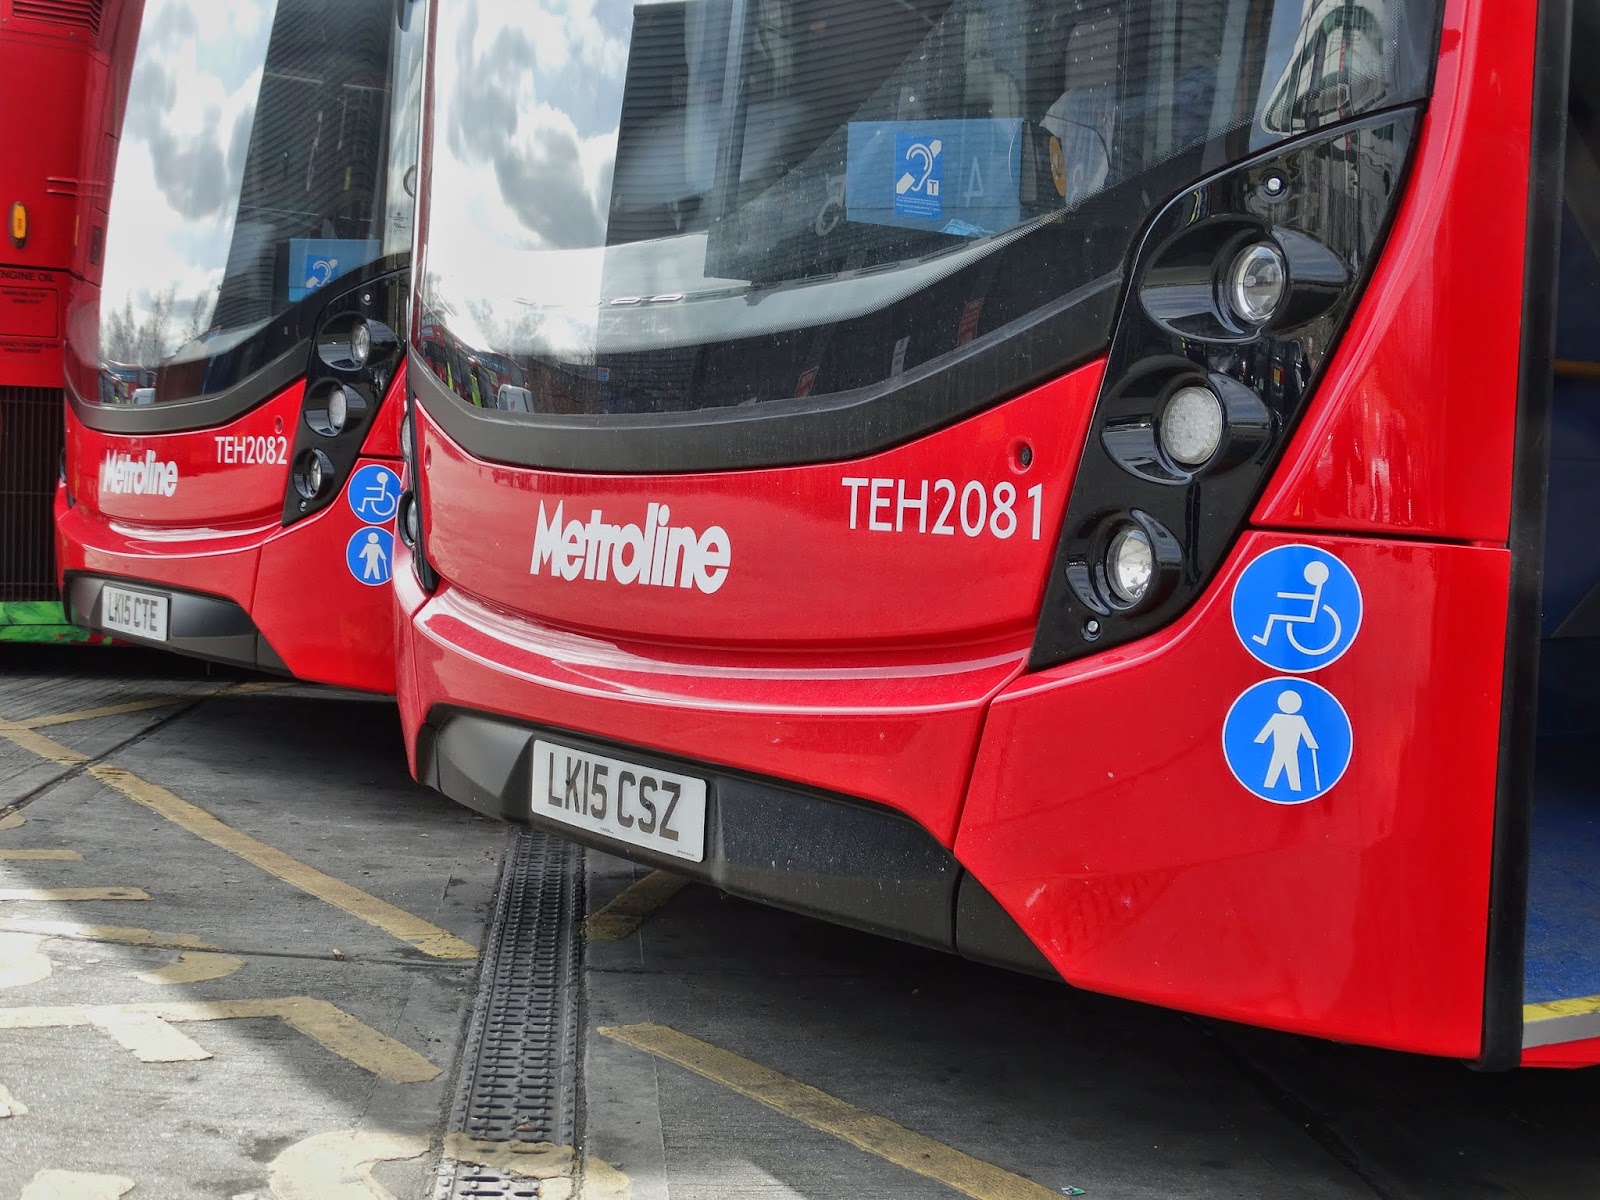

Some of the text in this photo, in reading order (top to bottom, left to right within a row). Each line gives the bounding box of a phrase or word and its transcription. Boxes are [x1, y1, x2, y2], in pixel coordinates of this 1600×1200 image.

[0, 270, 35, 280] NGINE
[103, 449, 178, 497] Metroline
[215, 436, 287, 465] TEH2082
[841, 477, 1043, 541] TEH2081
[530, 499, 731, 594] Metroline
[109, 592, 158, 632] LK15 CTE
[547, 752, 682, 842] LK15 CSZ
